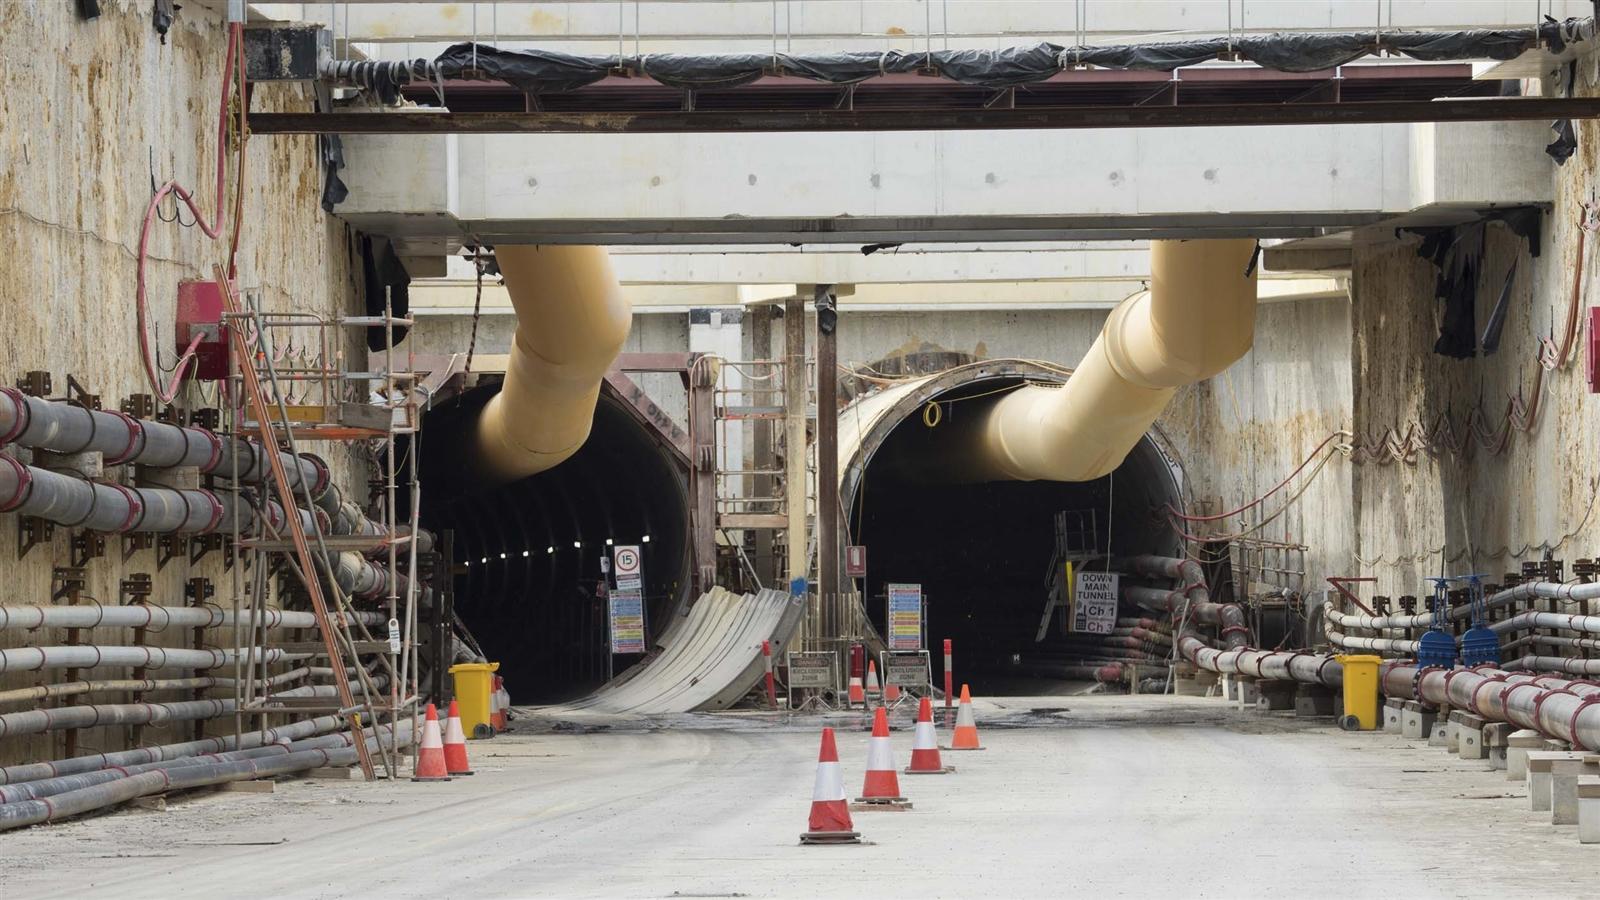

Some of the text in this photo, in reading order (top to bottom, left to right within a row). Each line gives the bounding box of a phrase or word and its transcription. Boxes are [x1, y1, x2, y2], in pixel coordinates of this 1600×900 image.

[622, 555, 633, 565] 15
[1082, 574, 1112, 582] DOWN
[1085, 583, 1110, 591] MAIN
[1077, 591, 1116, 600] TUNNEL
[1088, 606, 1114, 616] Ch 1
[1087, 622, 1113, 633] Ch 3
